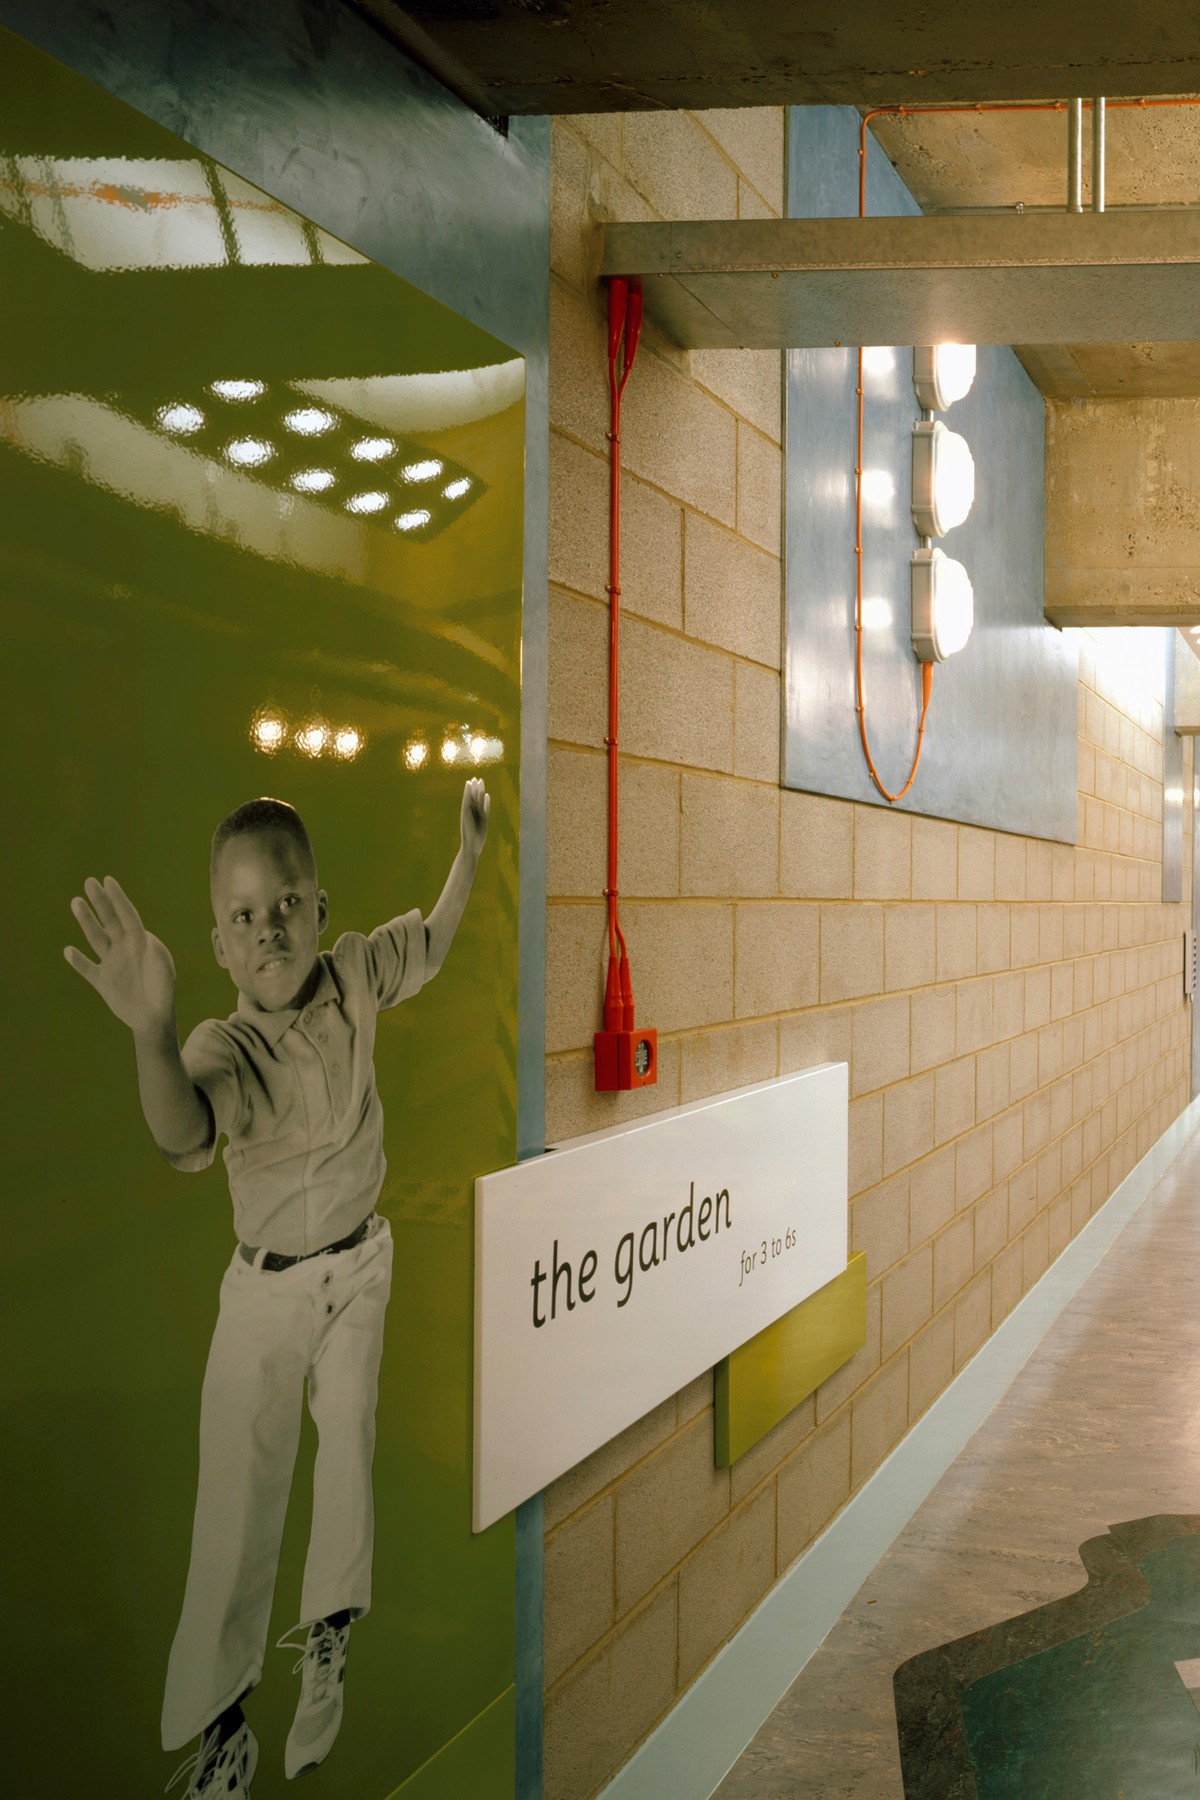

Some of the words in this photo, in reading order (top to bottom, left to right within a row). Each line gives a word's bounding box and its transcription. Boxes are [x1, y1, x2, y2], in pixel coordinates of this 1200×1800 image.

[530, 1239, 598, 1329] the
[614, 1181, 732, 1308] garden
[739, 1249, 757, 1287] for
[760, 1240, 767, 1265] 3
[771, 1237, 782, 1259] to
[785, 1226, 796, 1250] 6s
